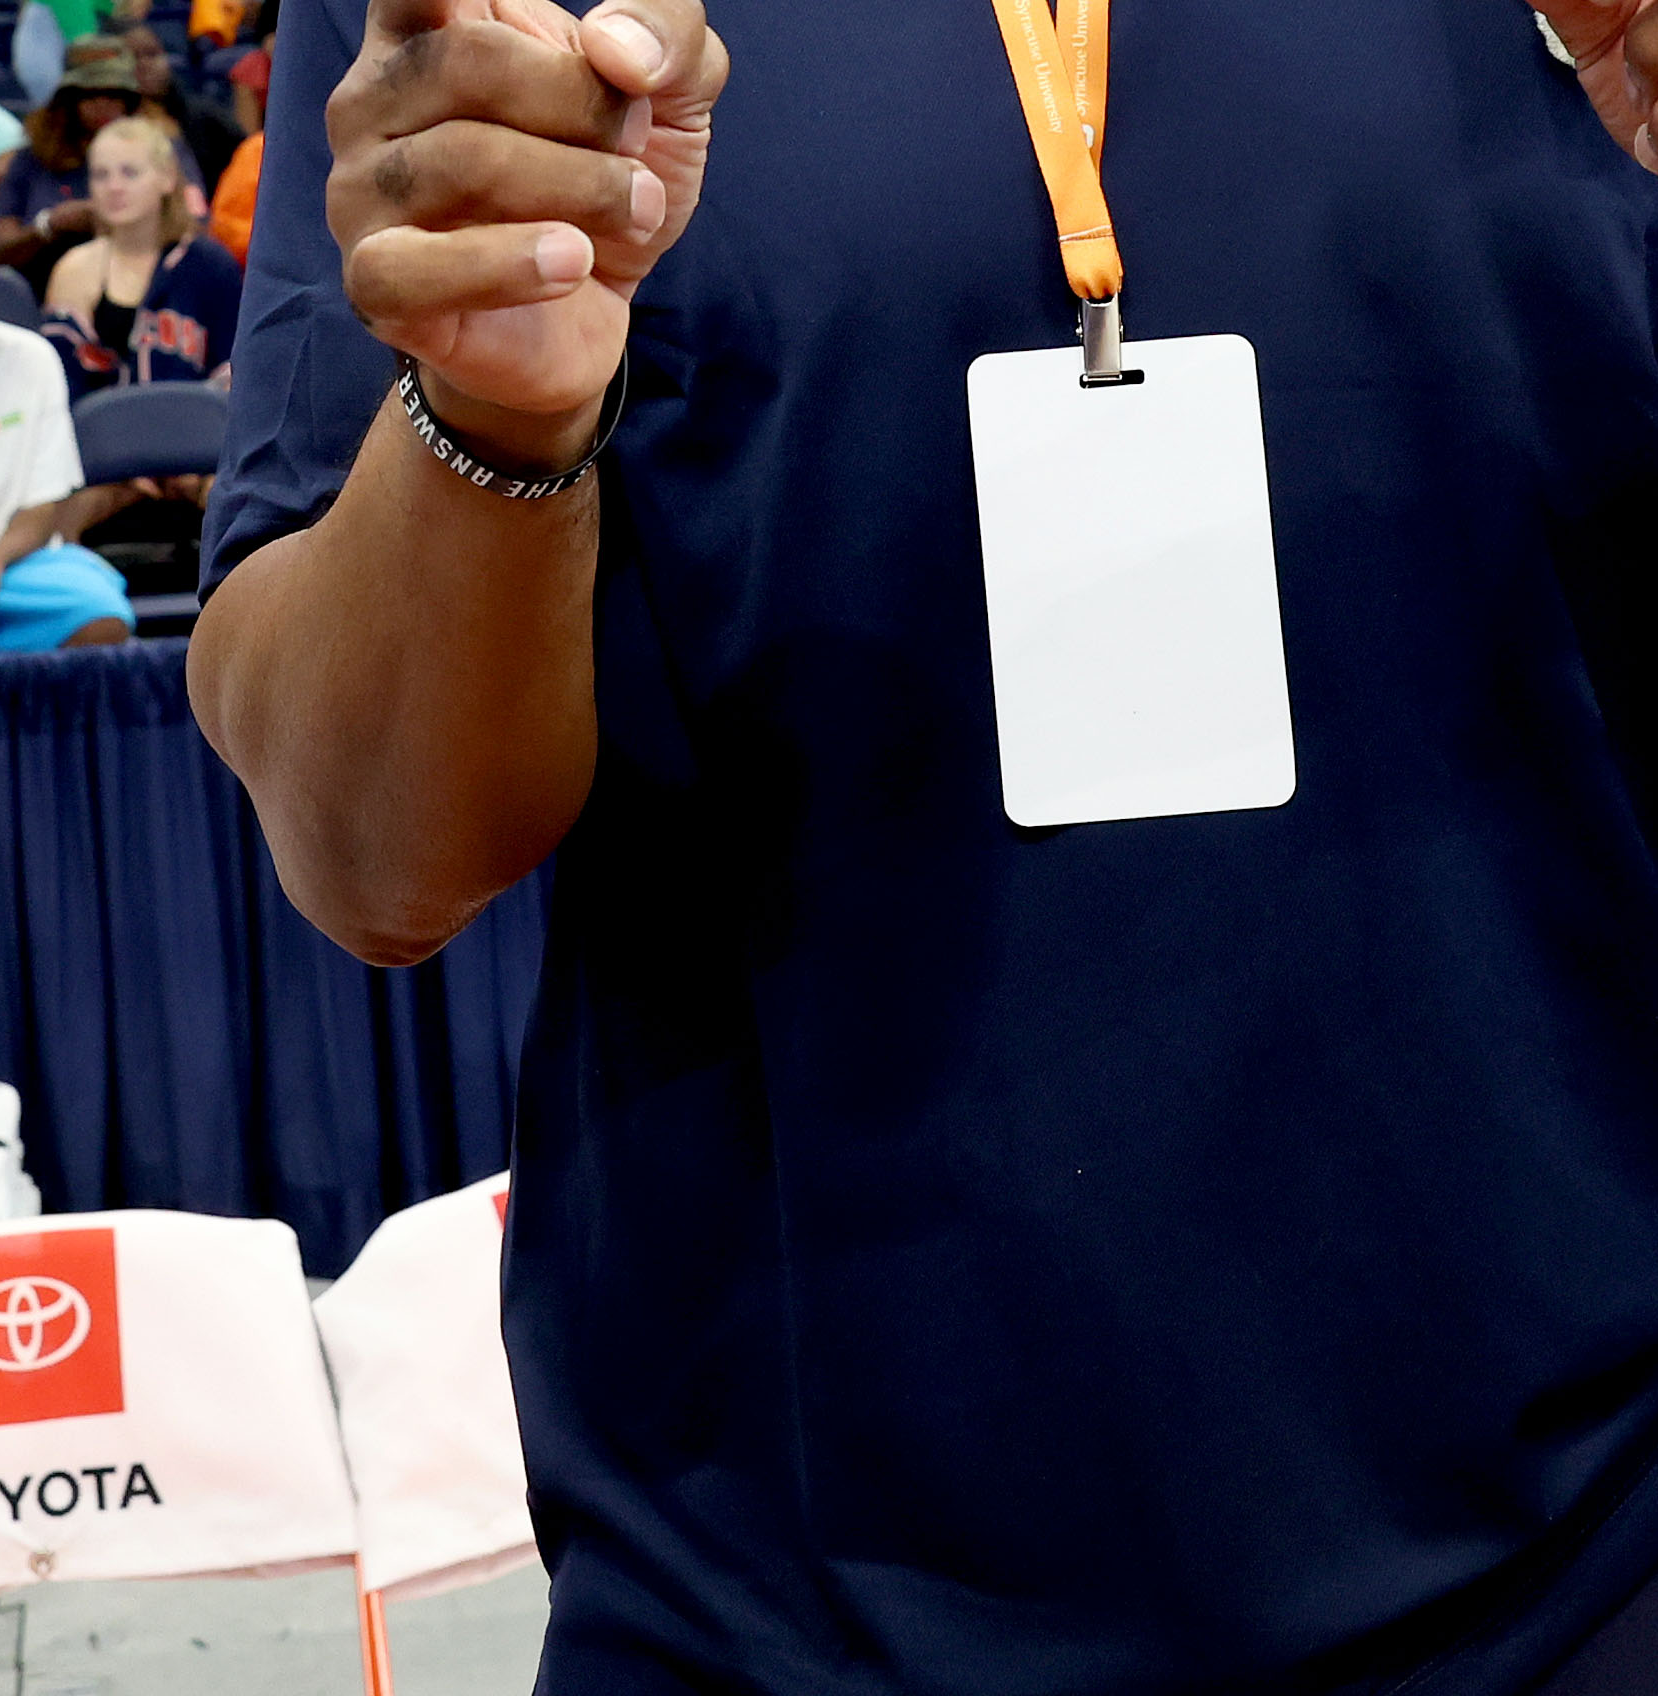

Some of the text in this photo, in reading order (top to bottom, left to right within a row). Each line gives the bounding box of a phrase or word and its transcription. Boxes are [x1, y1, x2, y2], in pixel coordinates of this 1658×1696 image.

[1035, 61, 1063, 134] University
[398, 370, 565, 499] THE ANSWER
